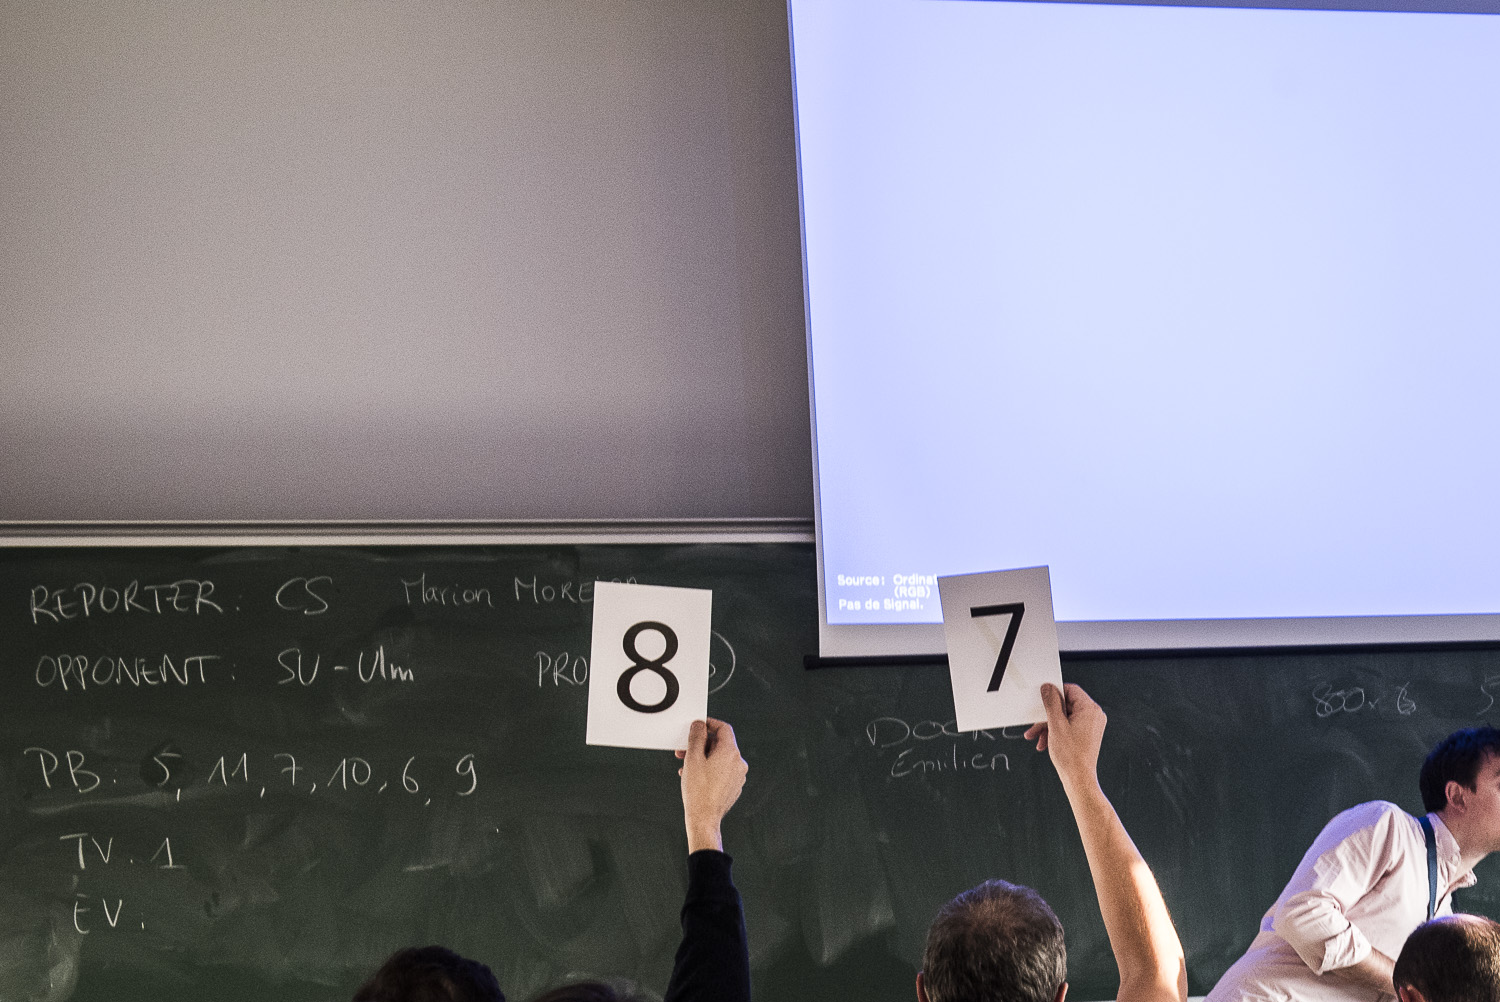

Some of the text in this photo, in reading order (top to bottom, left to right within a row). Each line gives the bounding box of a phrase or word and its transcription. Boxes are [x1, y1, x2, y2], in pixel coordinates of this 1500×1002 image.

[275, 576, 333, 615] CS
[401, 573, 494, 608] Marion
[837, 574, 885, 586] Source:
[894, 585, 931, 599] (RGB)
[839, 599, 861, 610] Pas
[864, 598, 880, 610] de
[970, 602, 1025, 693] 7
[616, 620, 680, 714] 8
[456, 753, 477, 796] 9
[151, 836, 186, 869] 1
